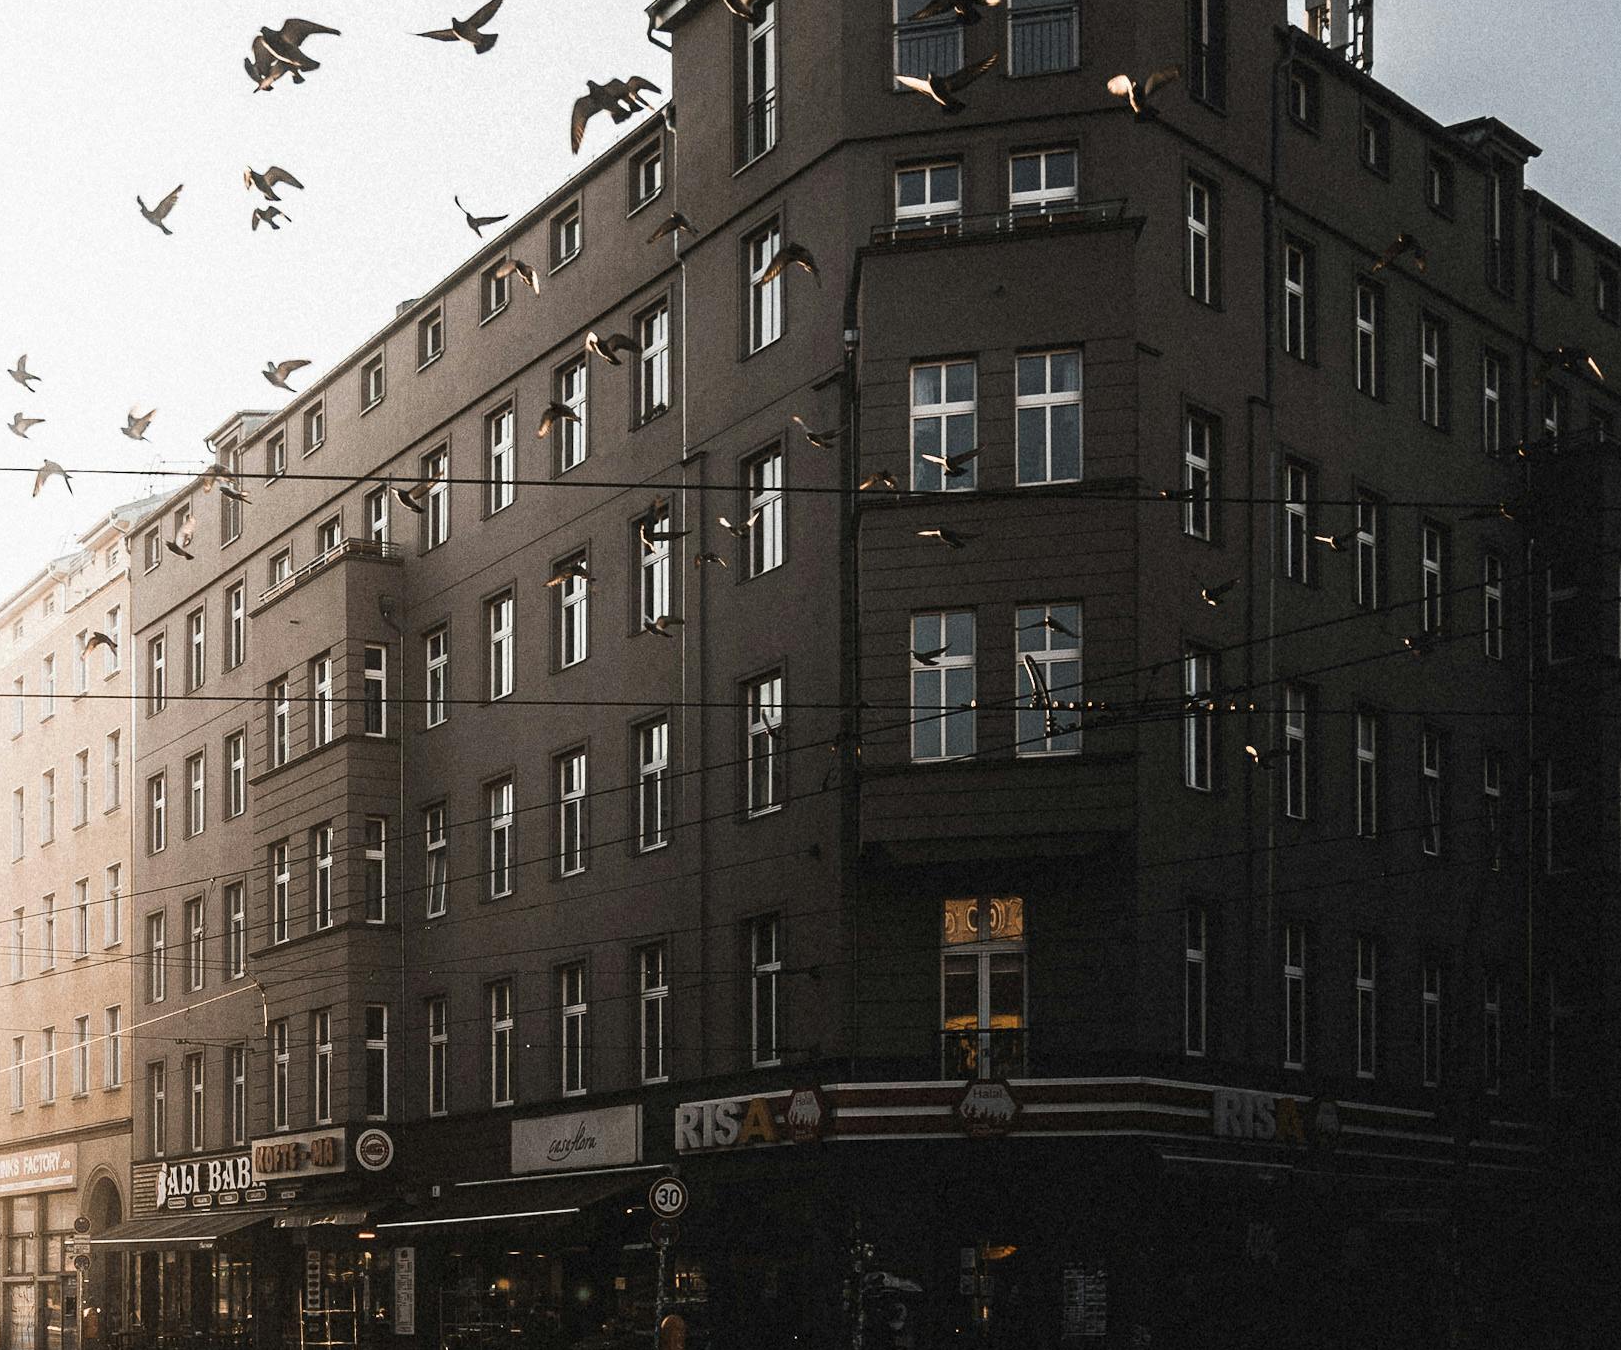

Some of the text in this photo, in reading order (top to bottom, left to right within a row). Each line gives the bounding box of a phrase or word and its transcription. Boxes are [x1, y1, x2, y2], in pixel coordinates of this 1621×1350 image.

[675, 1098, 775, 1150] RISA
[167, 1157, 267, 1197] ALI BAB
[658, 1188, 681, 1206] 30
